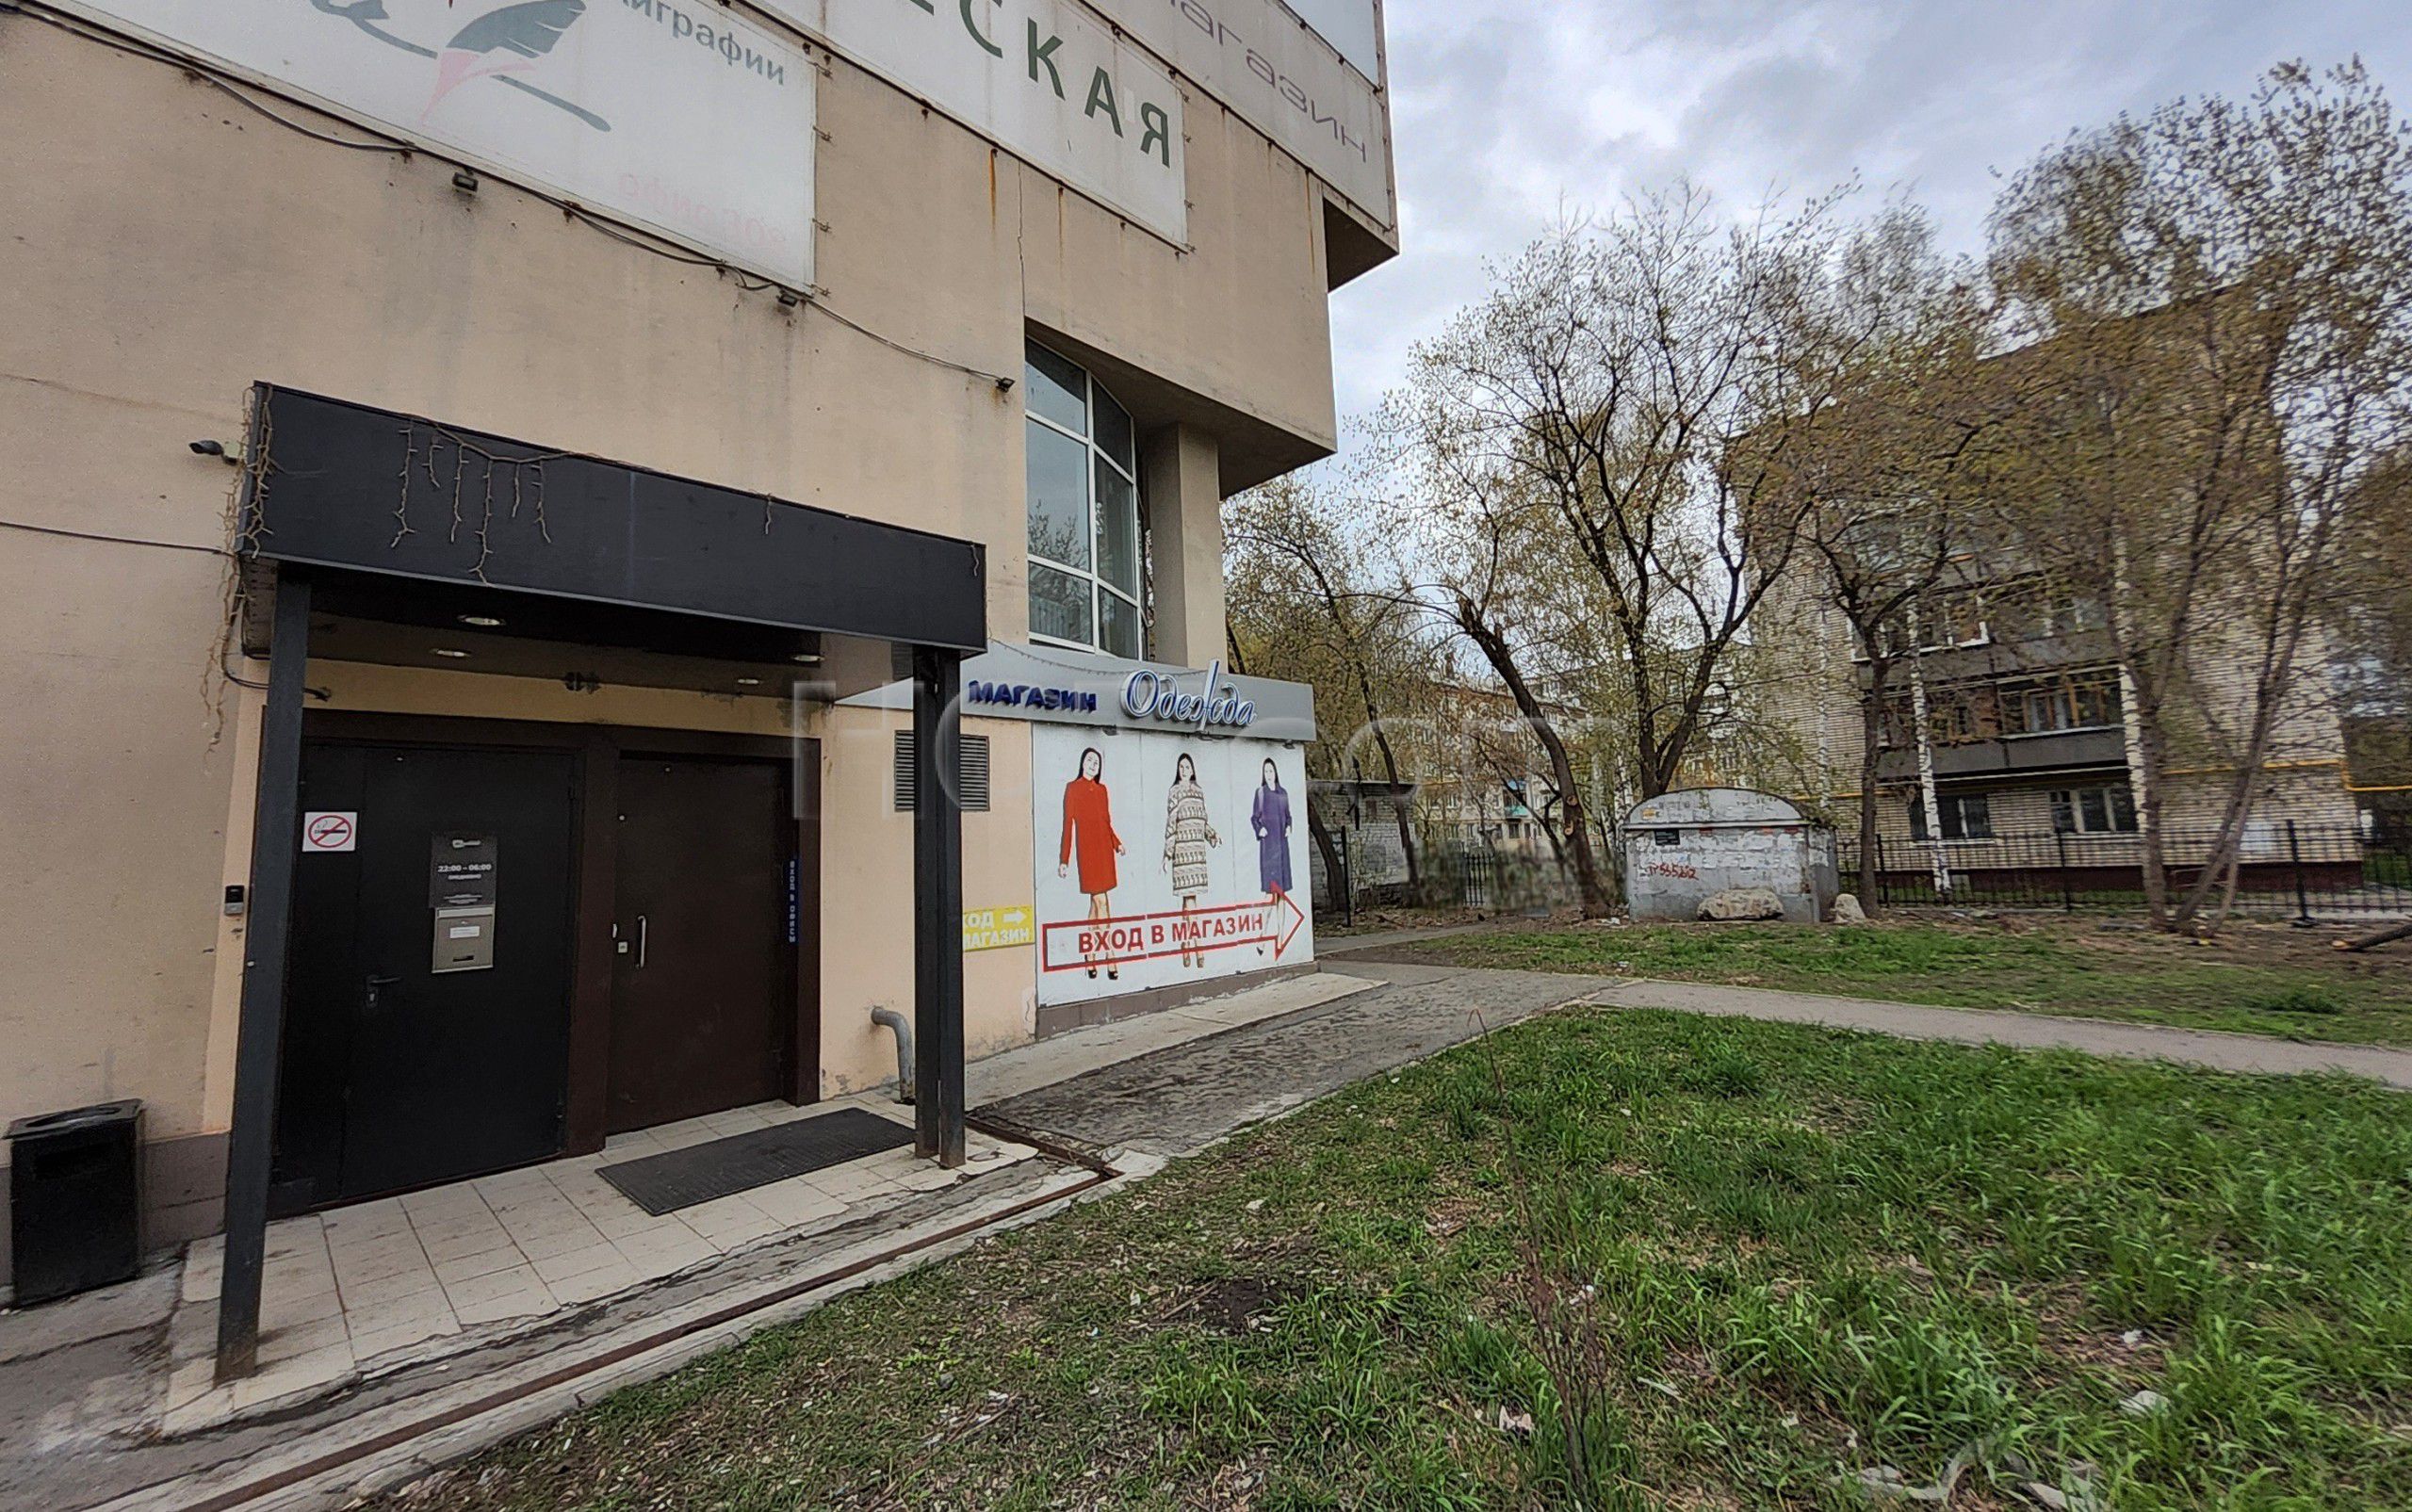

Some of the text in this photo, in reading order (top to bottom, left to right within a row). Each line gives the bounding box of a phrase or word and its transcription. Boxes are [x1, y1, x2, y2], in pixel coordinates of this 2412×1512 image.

[622, 0, 784, 86] играфии
[1169, 0, 1366, 163] агазин
[903, 0, 1171, 169] СКАЯ
[969, 658, 1258, 732] МАГАЗИН Одежда
[963, 911, 994, 929] ОД
[1078, 913, 1263, 954] ВХОД В МАГАЗИН
